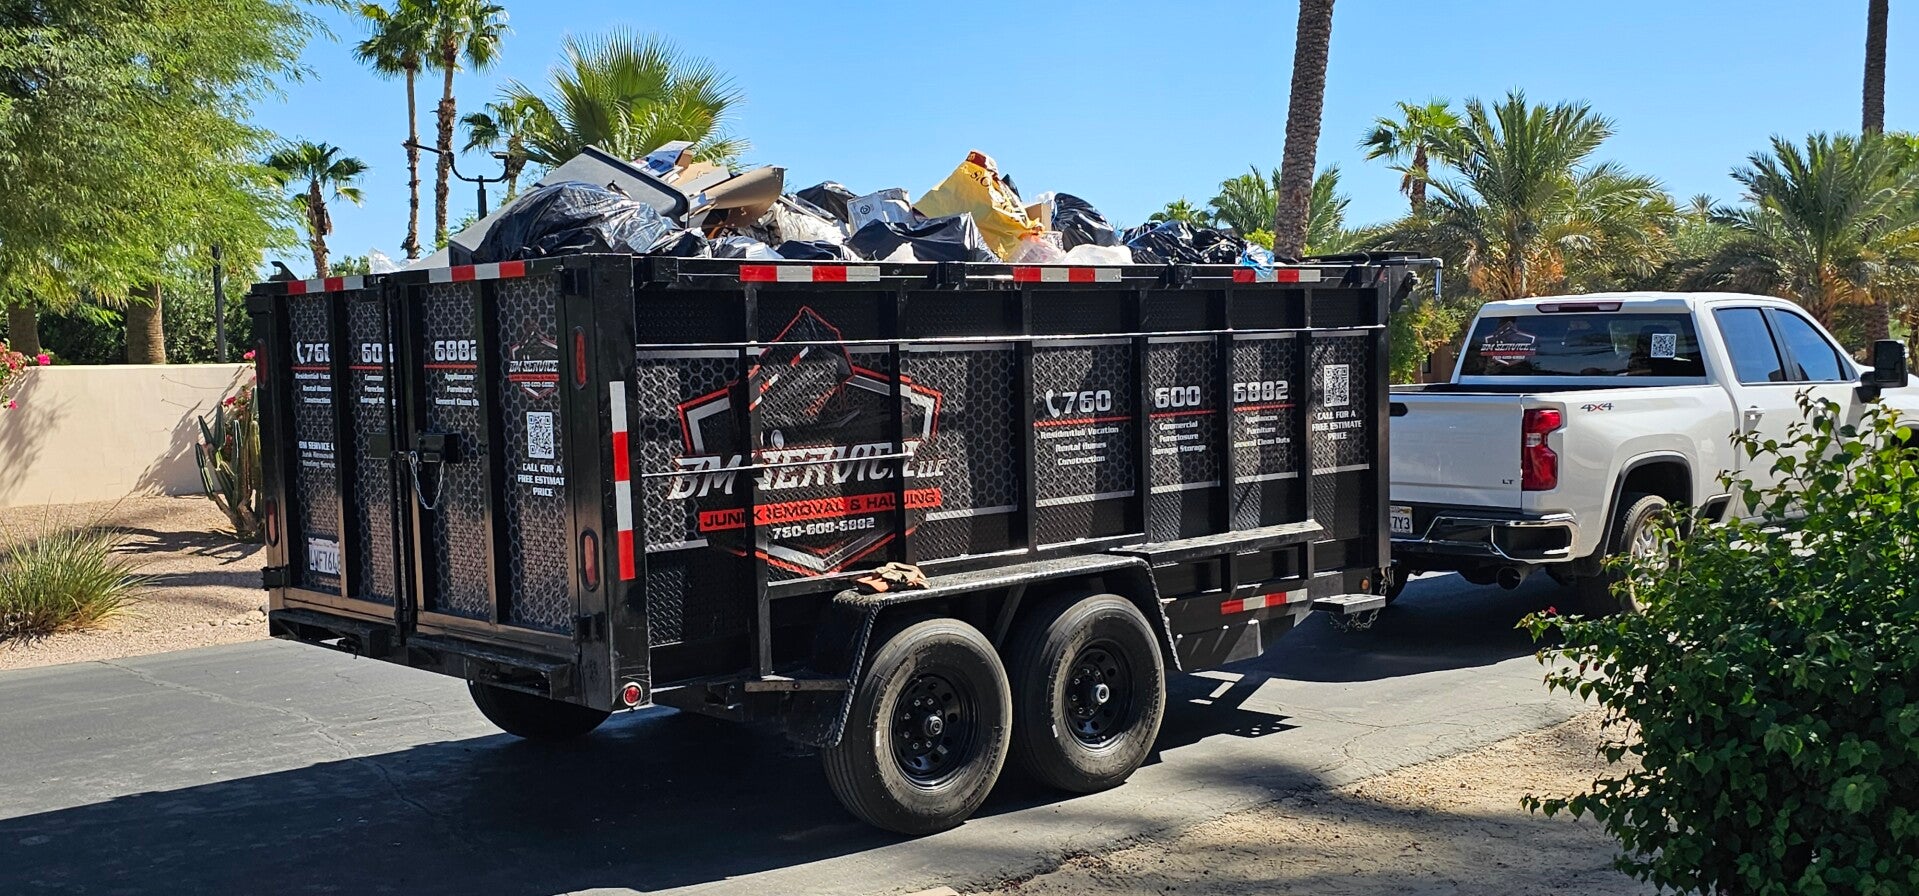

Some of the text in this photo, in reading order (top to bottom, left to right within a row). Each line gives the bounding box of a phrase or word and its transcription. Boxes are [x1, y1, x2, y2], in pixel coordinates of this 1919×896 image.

[522, 360, 559, 373] SERVICE
[1155, 386, 1201, 408] 600
[1233, 381, 1288, 403] 6882
[1062, 390, 1111, 414] 760
[1317, 409, 1357, 421] CALL FOR A
[1159, 420, 1199, 431] Commercial
[1246, 426, 1276, 435] Furniture
[1311, 420, 1362, 432] FREE ESTIMATE
[1040, 426, 1119, 440] Residential Vacation
[1159, 433, 1199, 443] Foreclosure
[1327, 431, 1348, 441] PRICE
[308, 440, 330, 452] SERVICE
[1055, 441, 1107, 453] Rental Homes
[1257, 438, 1275, 446] Clean
[1179, 444, 1207, 453] Storage
[1057, 454, 1106, 466] Construction
[522, 462, 563, 474] CALL FOR A
[667, 440, 949, 500] BM SERVICE LLC
[517, 473, 534, 484] FREE
[532, 486, 554, 497] PRICE
[703, 507, 763, 528] JUNK
[767, 499, 845, 519] REMOVAL
[849, 498, 861, 511] &
